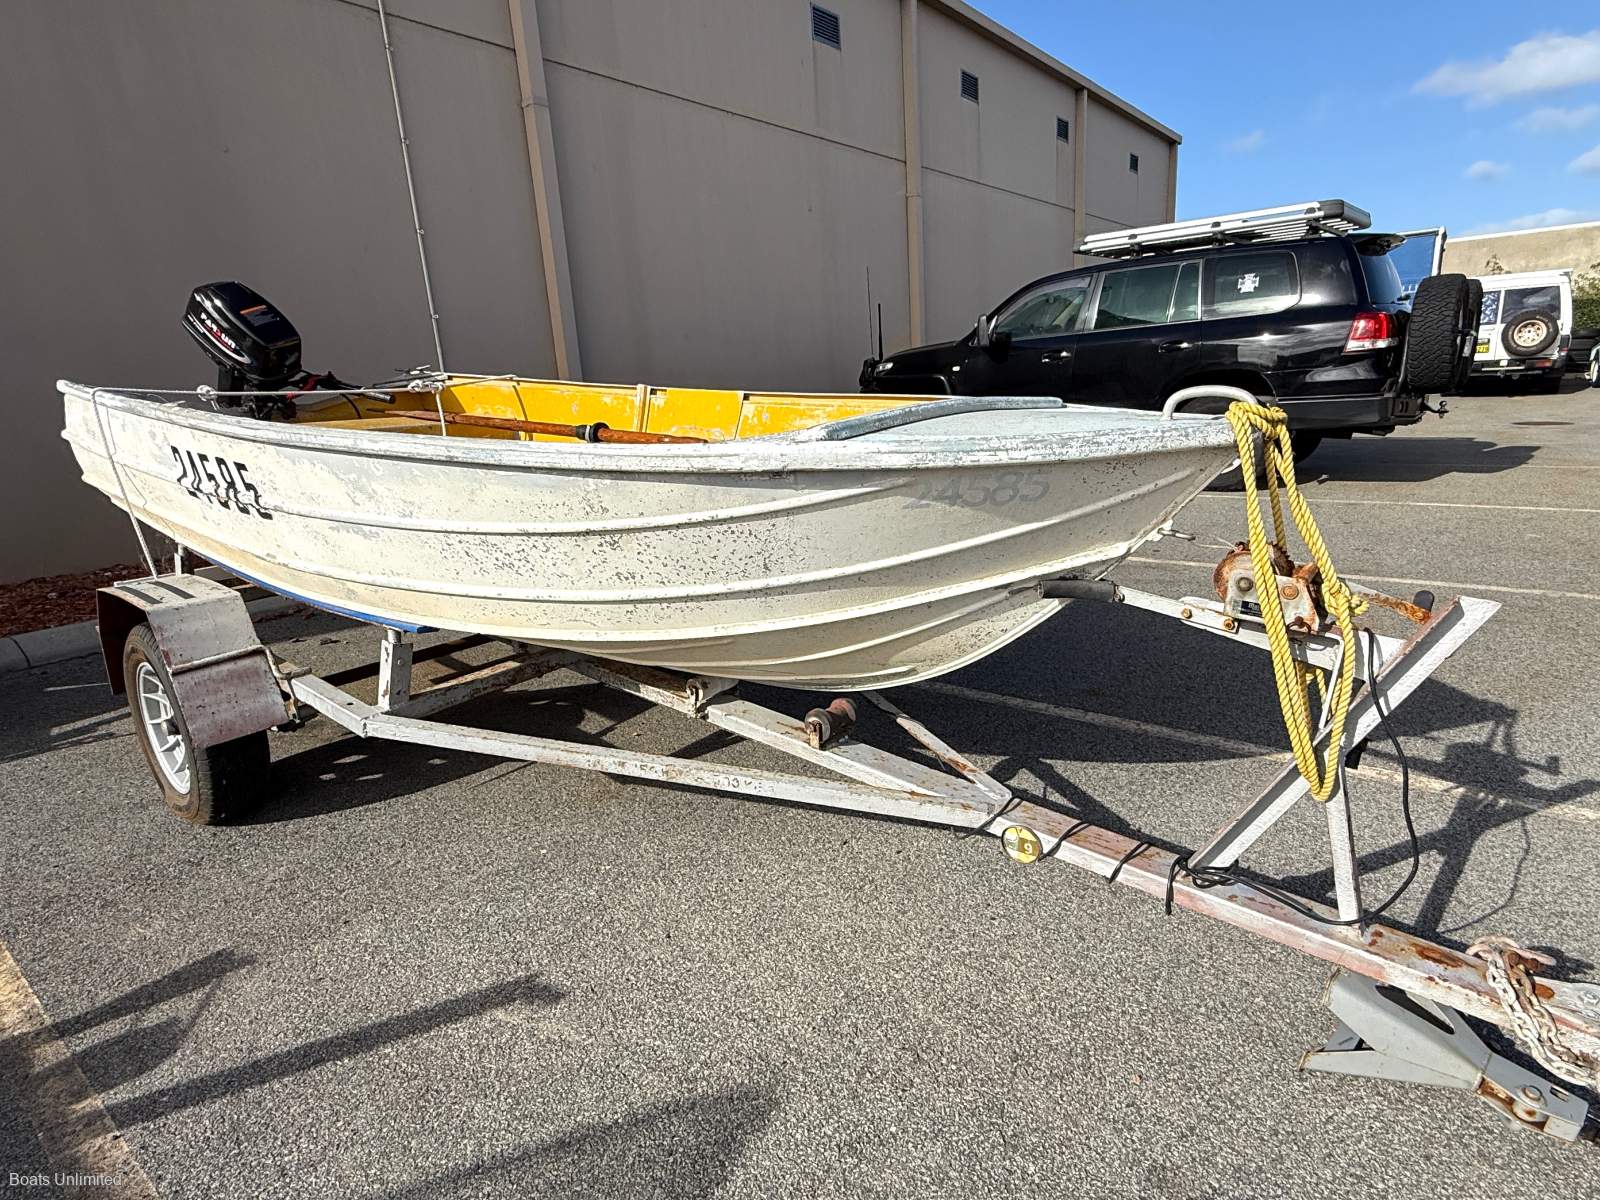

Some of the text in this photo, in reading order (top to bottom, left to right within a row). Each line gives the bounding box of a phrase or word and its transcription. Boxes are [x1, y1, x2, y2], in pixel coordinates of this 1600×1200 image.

[170, 445, 273, 520] 24585
[902, 470, 1050, 509] 24585
[1023, 842, 1033, 855] 9
